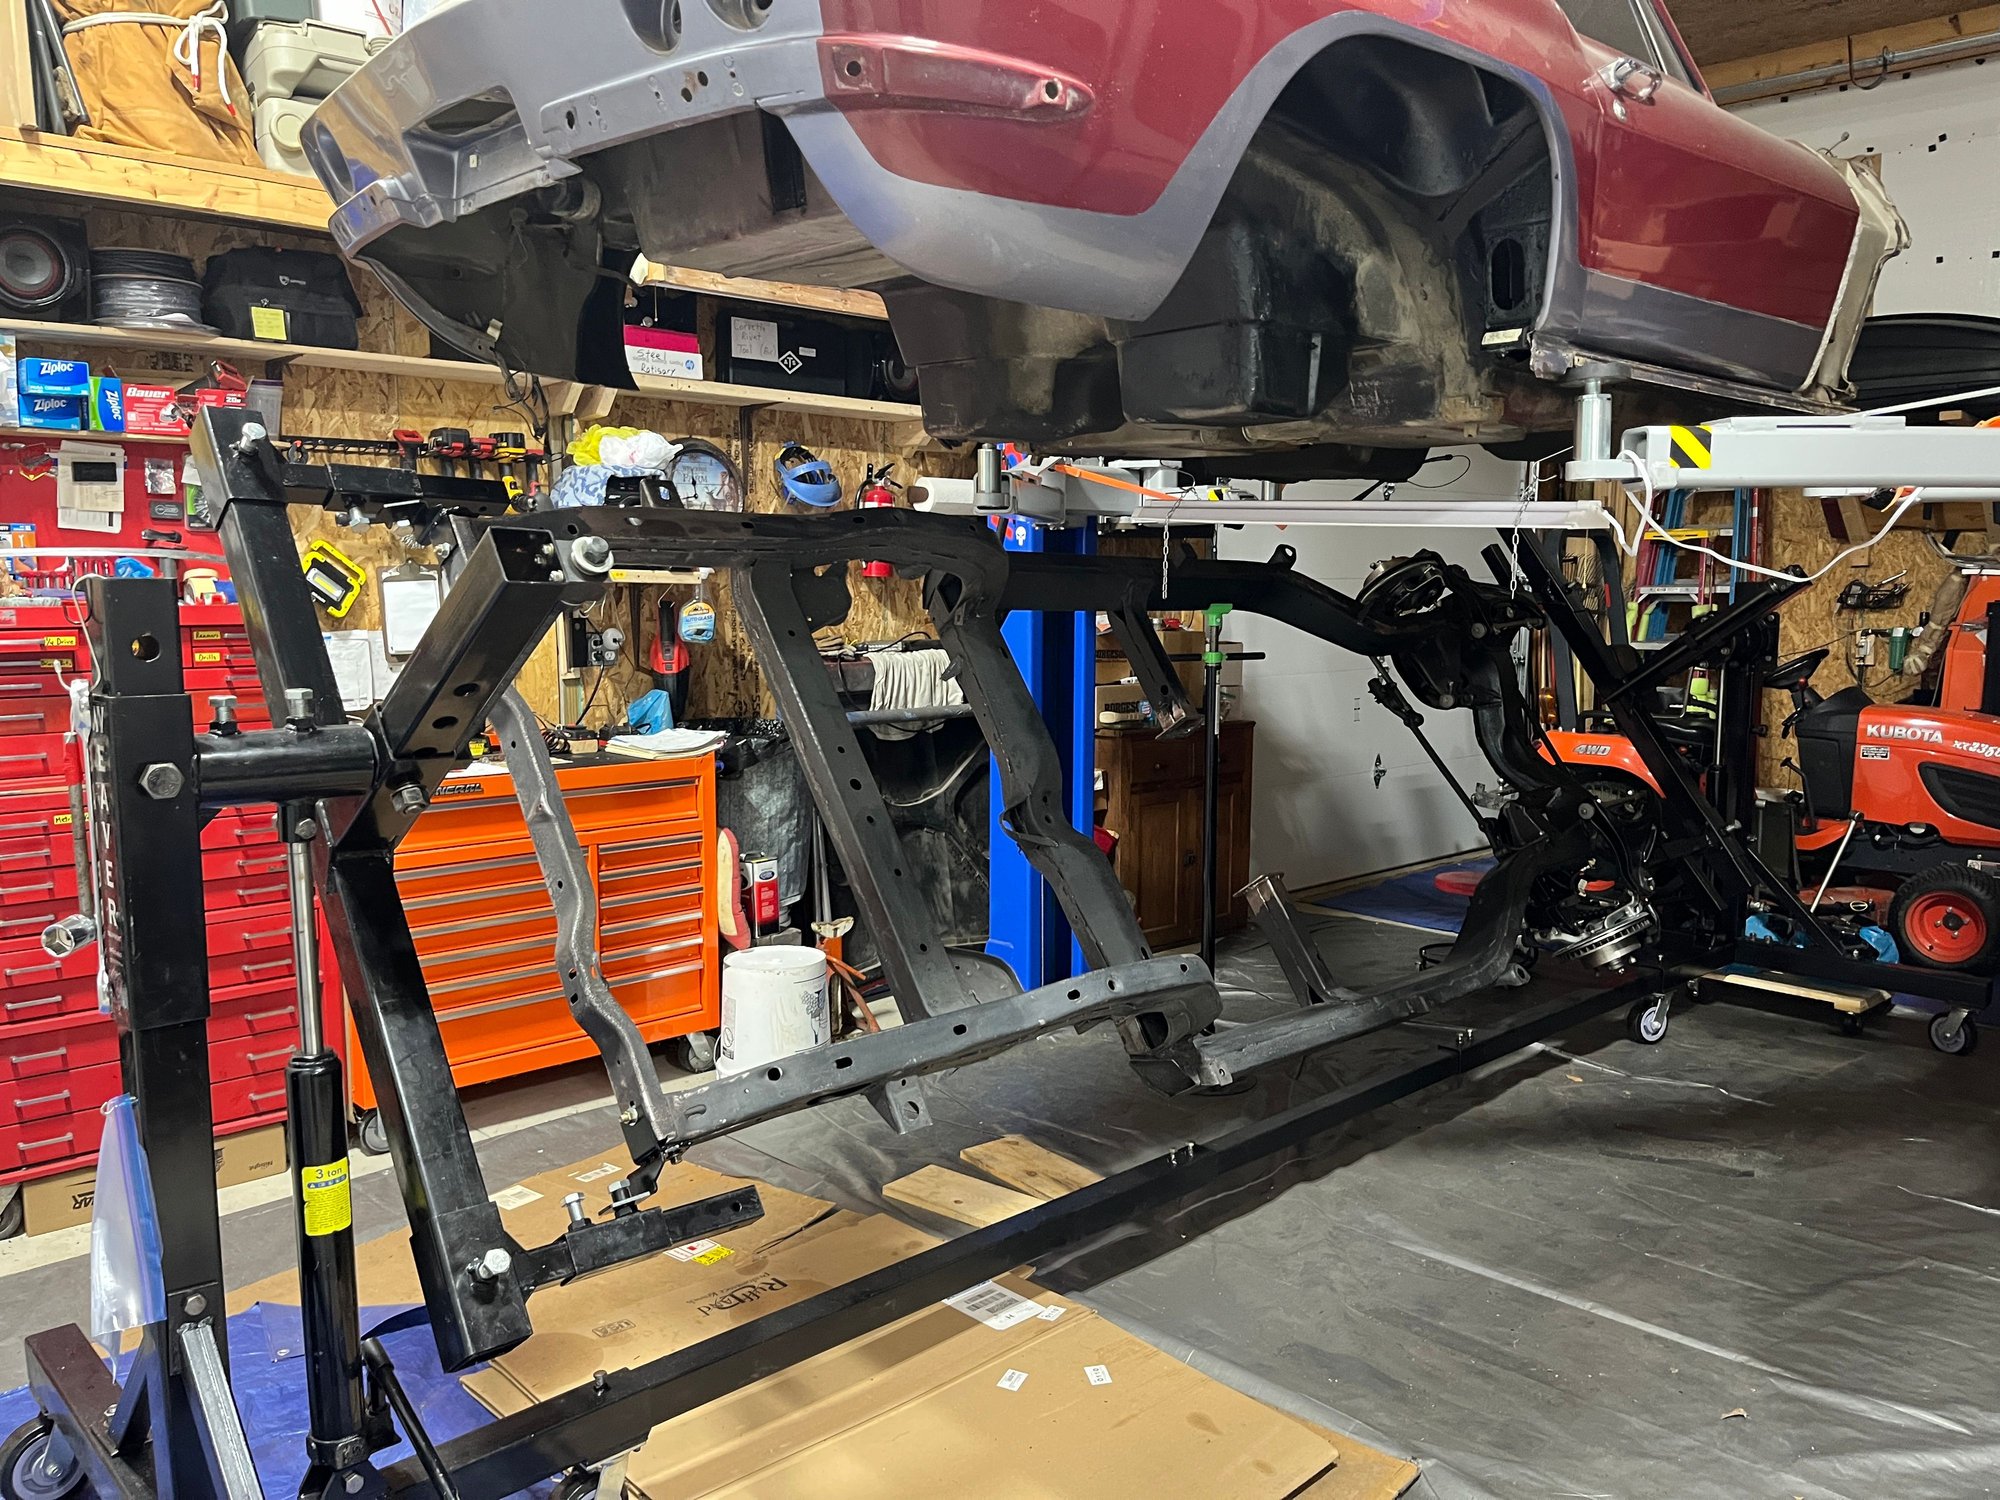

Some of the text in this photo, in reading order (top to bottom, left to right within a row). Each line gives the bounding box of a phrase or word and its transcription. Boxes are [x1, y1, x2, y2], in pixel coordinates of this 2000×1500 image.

[637, 349, 666, 361] Steel
[39, 361, 75, 376] Ziploc
[126, 387, 170, 399] Bauer
[33, 399, 68, 412] Ziploc
[104, 390, 122, 421] Ziploc
[57, 637, 74, 645] Drive
[1866, 724, 1943, 744] KUBOTA
[1573, 744, 1612, 756] 4WD
[434, 783, 482, 796] NERAL
[315, 1167, 343, 1180] 3 ton
